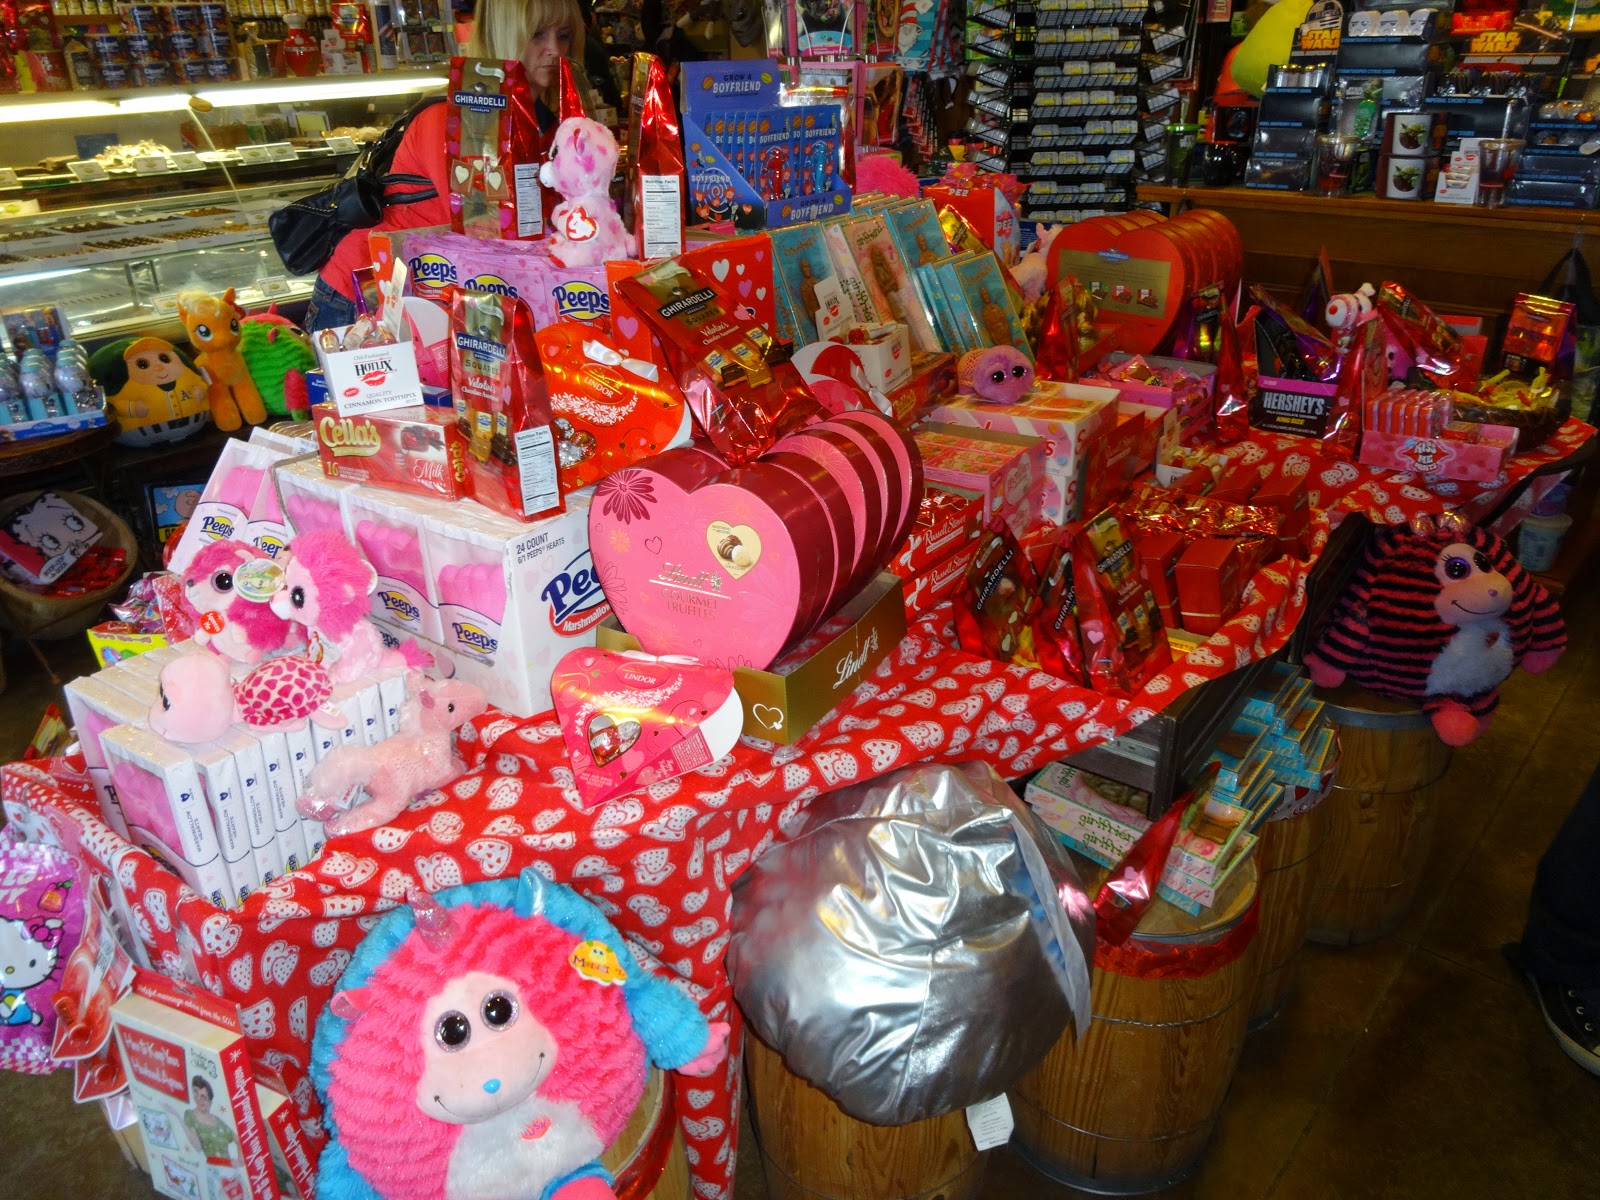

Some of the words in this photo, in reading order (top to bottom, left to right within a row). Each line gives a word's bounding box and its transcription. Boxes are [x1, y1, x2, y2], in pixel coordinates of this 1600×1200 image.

[1470, 41, 1520, 53] WARS
[1479, 31, 1522, 43] STAR
[712, 81, 761, 94] BOYFRIEND
[454, 93, 506, 108] GHIRARDELLI
[759, 132, 790, 144] BOYFRIEND
[805, 128, 836, 138] BOYFRIEND
[691, 175, 731, 183] BOYFRIEND
[948, 188, 969, 197] PEZ
[409, 256, 457, 282] Peeps
[552, 286, 609, 314] Peeps
[661, 289, 715, 317] GHIRARDELLI
[685, 308, 720, 326] SQUARES
[457, 336, 506, 358] GHIRARDELLI
[355, 360, 393, 376] HOTLIX
[465, 360, 499, 375] SQUARES
[366, 390, 392, 399] QUALITY
[584, 376, 614, 399] LINDOR
[344, 398, 382, 409] CINNAMON
[383, 393, 417, 404] TOOTHPIX
[1263, 391, 1325, 416] HERSHEY'S
[319, 416, 381, 448] Cella's
[517, 432, 536, 441] Nutrition
[326, 461, 339, 476] 16
[413, 459, 444, 481] Milk
[203, 516, 235, 538] Peeps
[923, 524, 948, 546] Russell
[947, 515, 966, 532] Stover
[516, 543, 526, 555] 24
[526, 532, 549, 550] COUNT
[517, 553, 526, 565] 6/1
[546, 537, 565, 552] HEARTS
[1097, 542, 1132, 573] GHIRARDELLI
[658, 562, 710, 588] Lindt
[929, 561, 953, 585] Russell
[976, 549, 1014, 611] GHIRARDELLI
[378, 591, 420, 622] Peeps
[661, 588, 718, 609] GOURMET
[666, 601, 716, 620] TRUFFLES
[452, 622, 498, 652] Peeps
[832, 640, 872, 690] Lindt
[624, 672, 657, 685] LINDOR
[230, 816, 238, 837] HEARTS
[250, 795, 260, 836] MARSHMALLOW
[186, 810, 202, 853] MARSHMALLOW
[194, 817, 204, 841] HEARTS
[224, 809, 235, 850] MARSHMALLOW
[232, 1065, 252, 1098] Apron
[234, 1097, 258, 1144] Husband
[284, 1122, 301, 1153] Apron
[244, 1136, 263, 1166] Your
[250, 1153, 271, 1184] Keep
[286, 1143, 313, 1184] Husband
